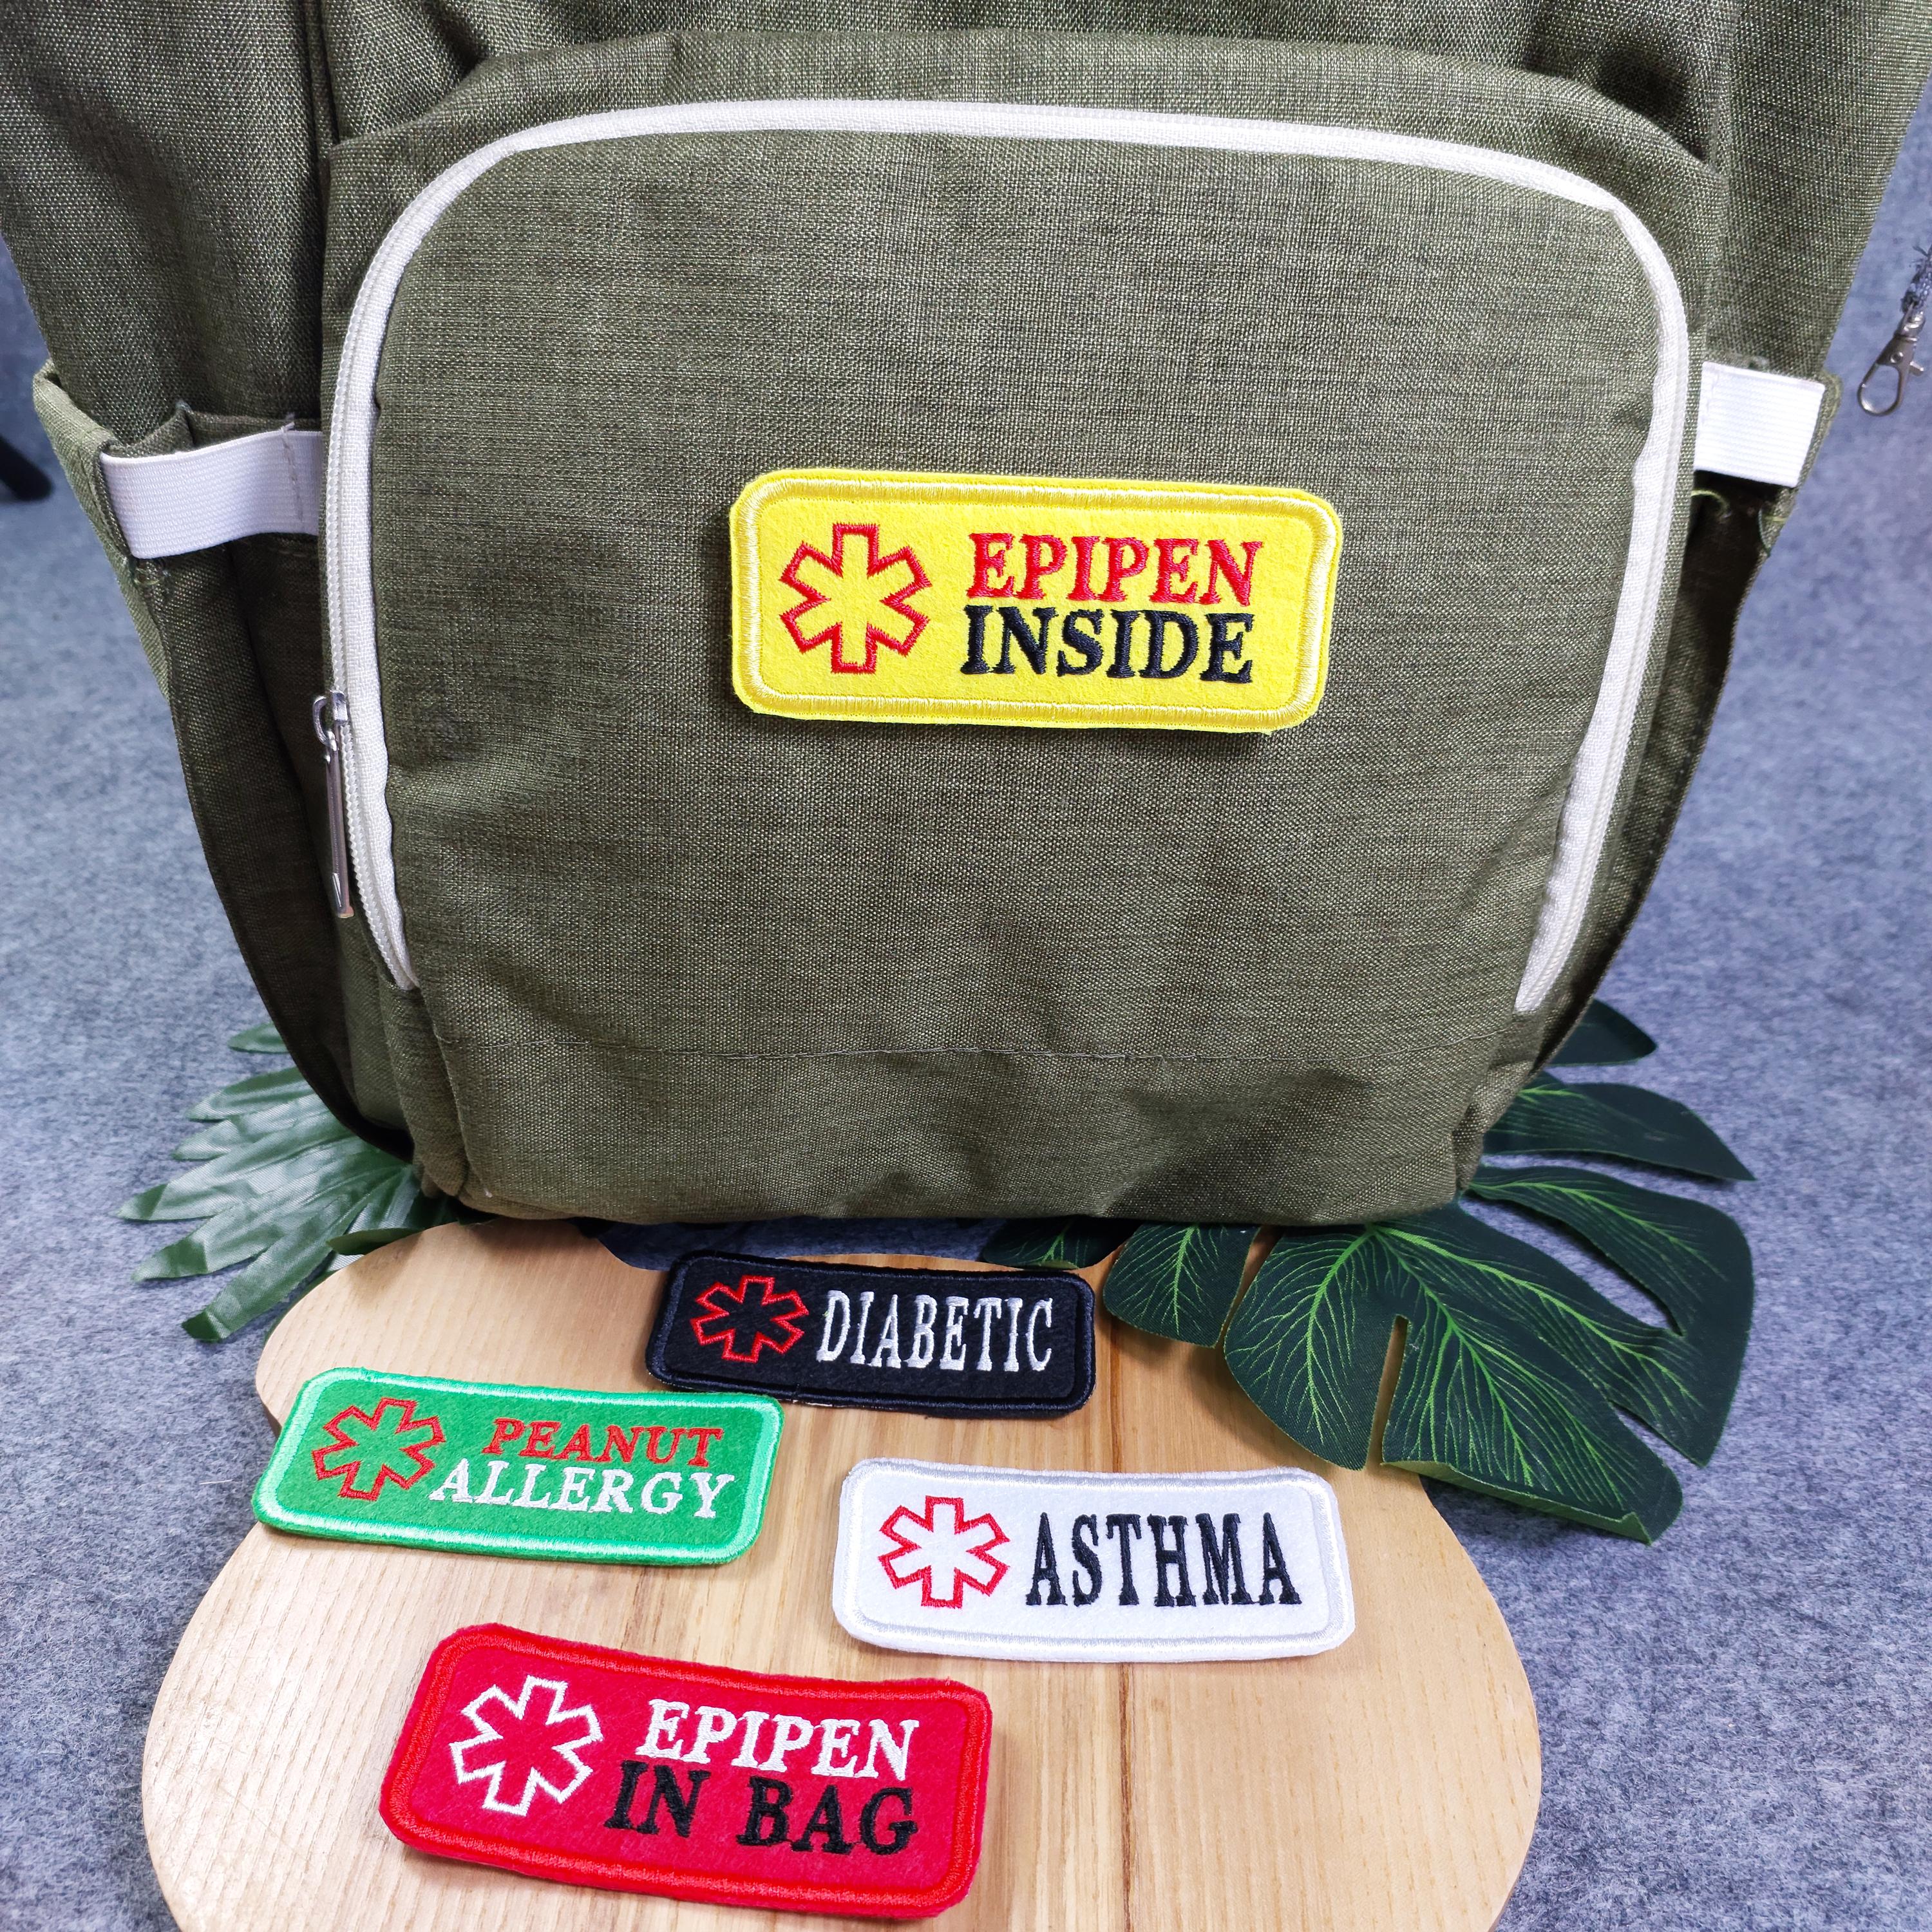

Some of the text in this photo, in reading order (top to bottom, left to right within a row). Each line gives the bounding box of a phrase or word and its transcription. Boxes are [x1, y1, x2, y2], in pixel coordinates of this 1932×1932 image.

[968, 532, 1263, 607] EPIPEN
[960, 605, 1254, 683] INSIDE
[816, 1290, 1054, 1372] DIABETIC
[482, 1418, 723, 1466] PEANUT
[430, 1458, 735, 1518] ALLERGY
[1026, 1512, 1302, 1607] ASTHMA
[635, 1698, 920, 1781] EPIPEN
[604, 1761, 918, 1855] IN BAG
